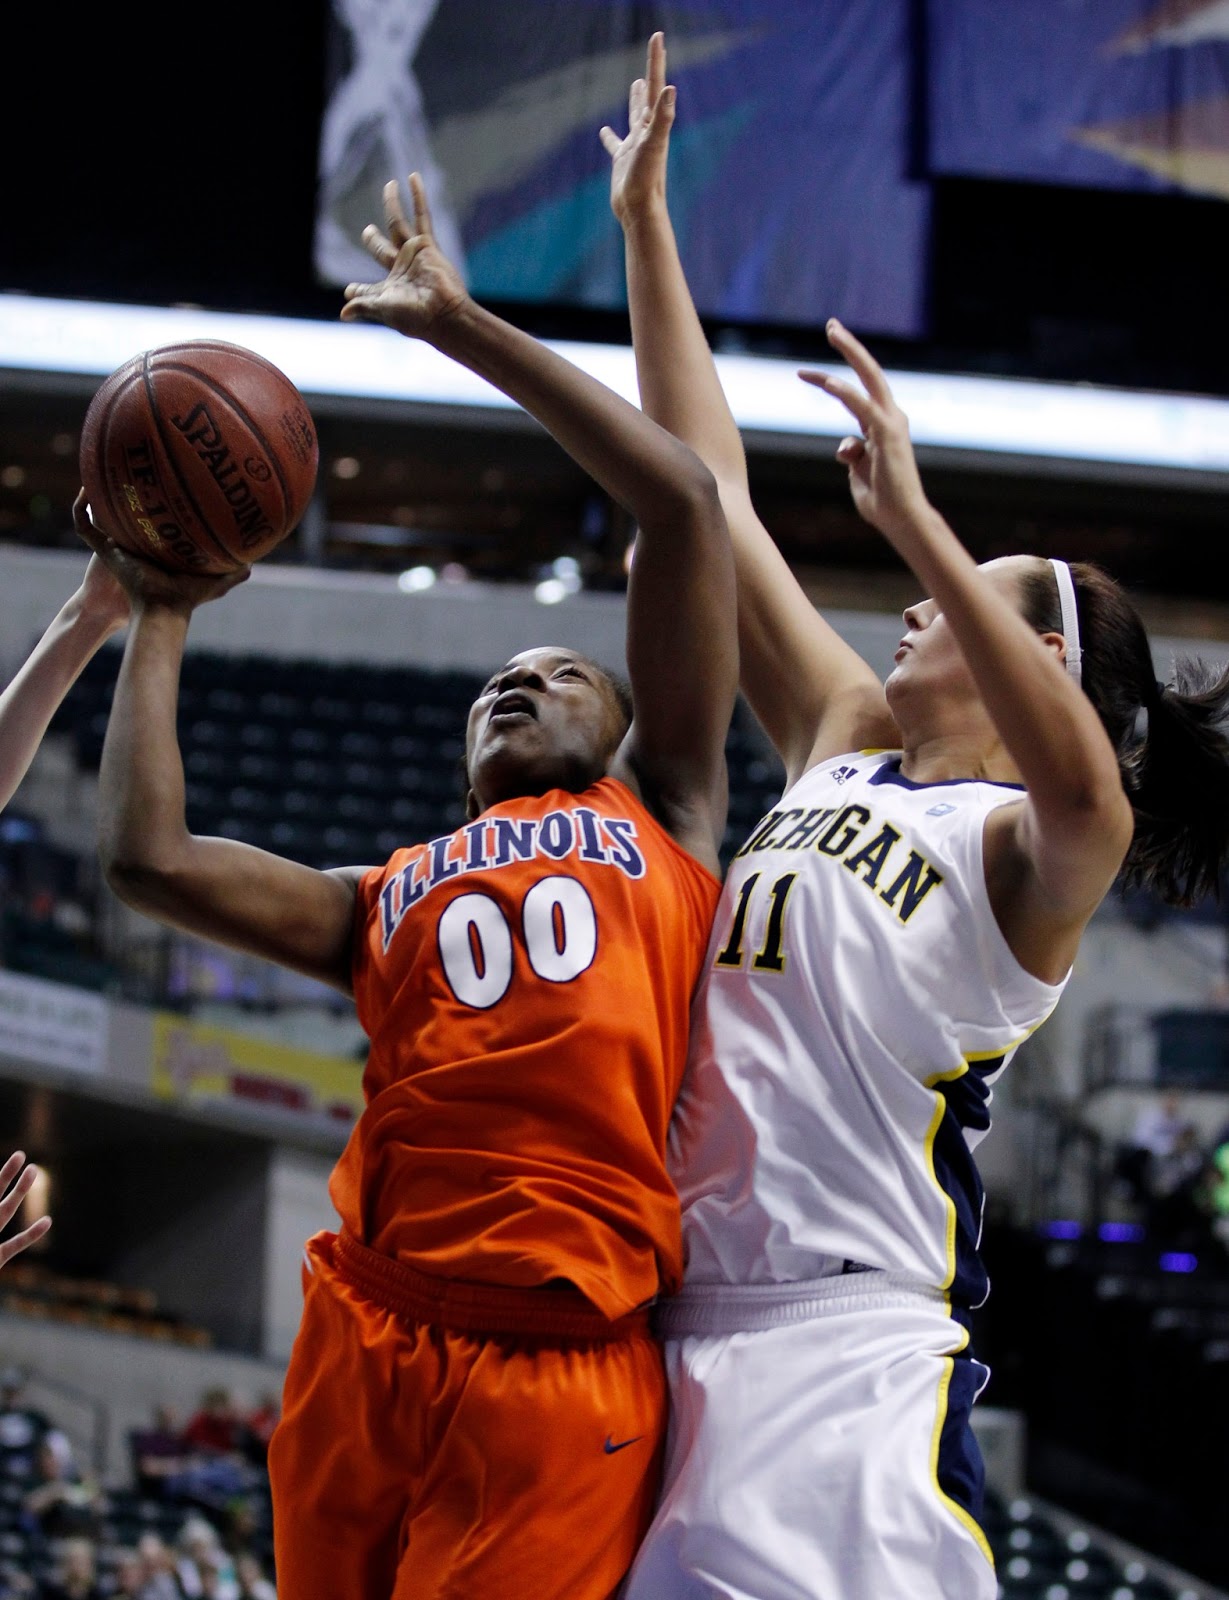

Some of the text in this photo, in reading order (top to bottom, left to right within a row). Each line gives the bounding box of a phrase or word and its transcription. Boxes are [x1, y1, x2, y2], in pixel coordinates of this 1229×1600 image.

[170, 402, 273, 548] SPALDING
[379, 807, 646, 955] ILLINOIS
[714, 871, 799, 975] 11
[731, 804, 944, 926] ICHGAN
[438, 875, 598, 1011] 00
